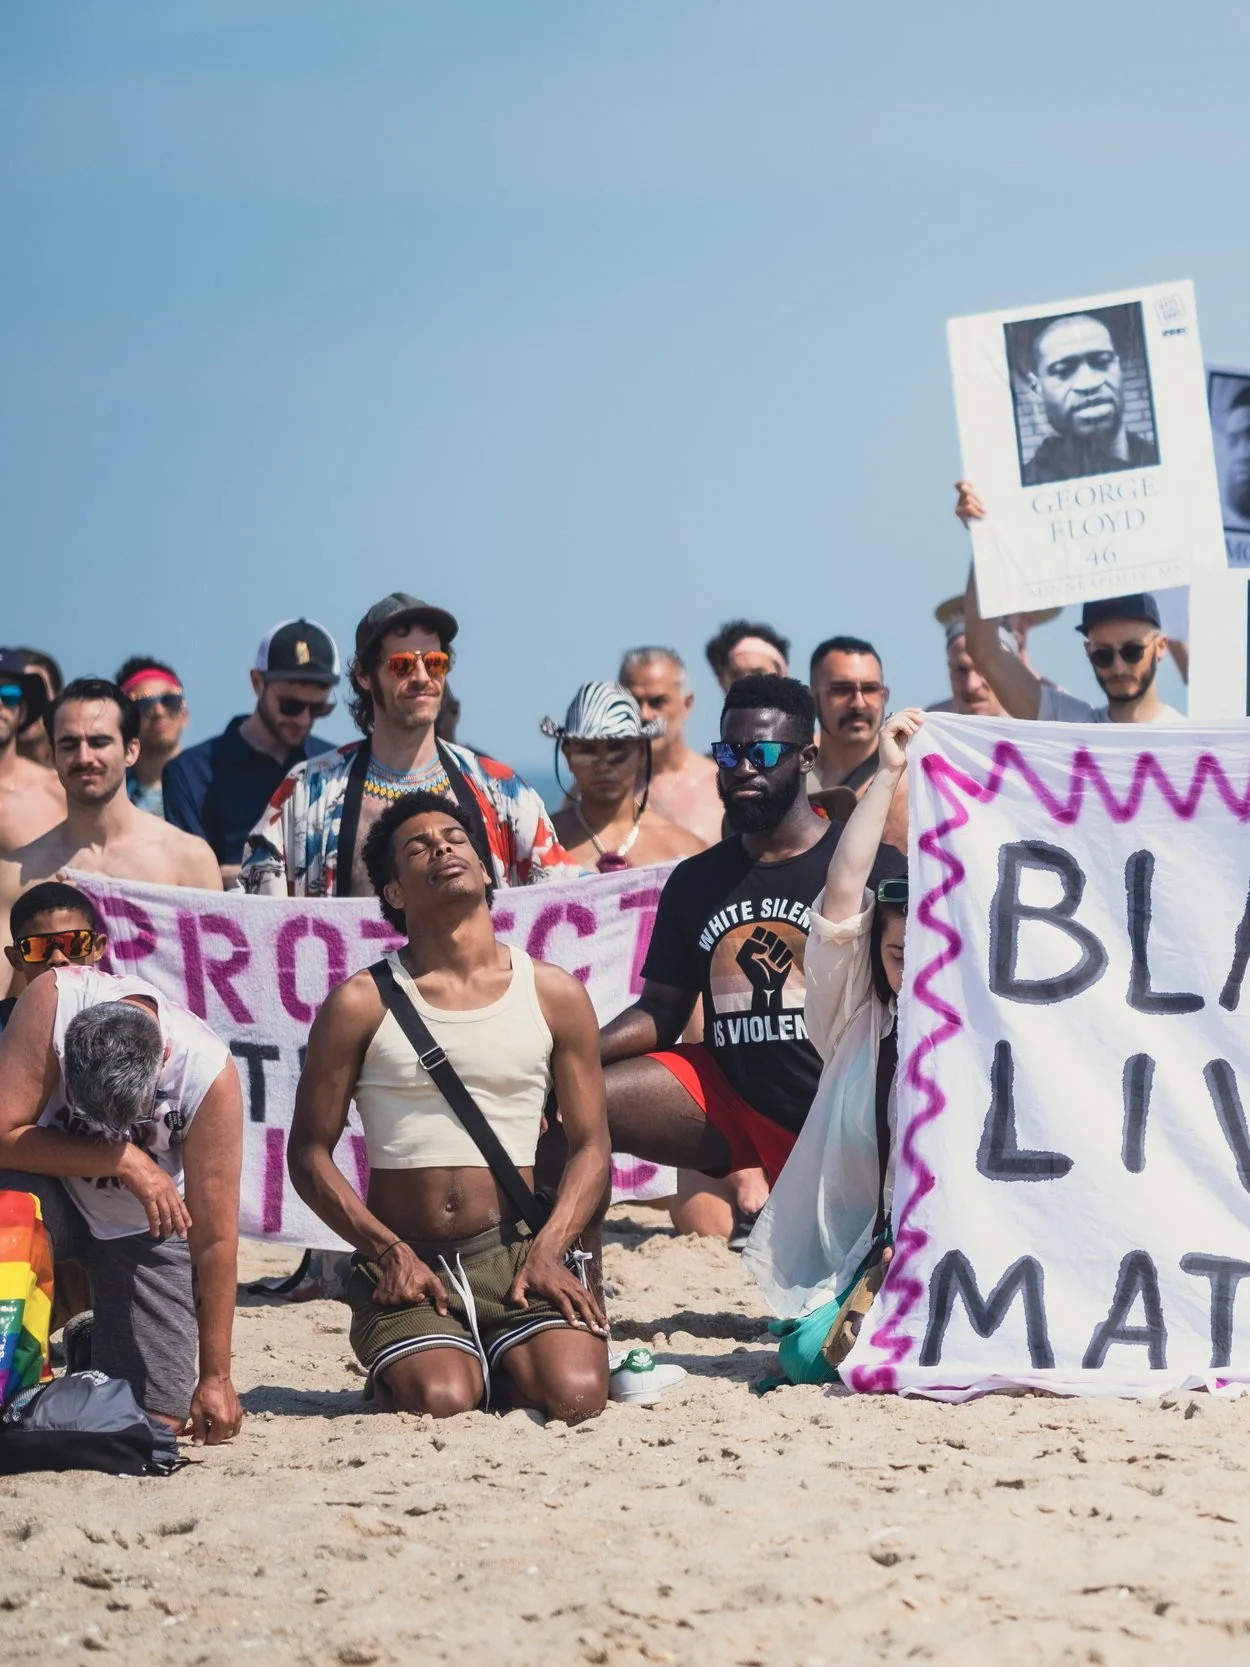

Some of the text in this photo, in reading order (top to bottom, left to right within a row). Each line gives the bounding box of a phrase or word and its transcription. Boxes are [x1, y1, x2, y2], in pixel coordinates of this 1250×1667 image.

[1032, 476, 1160, 515] GEORGE
[1051, 508, 1146, 543] FLOYD
[1086, 544, 1117, 566] 46
[699, 900, 754, 952] WHITE
[713, 1021, 726, 1048] IS
